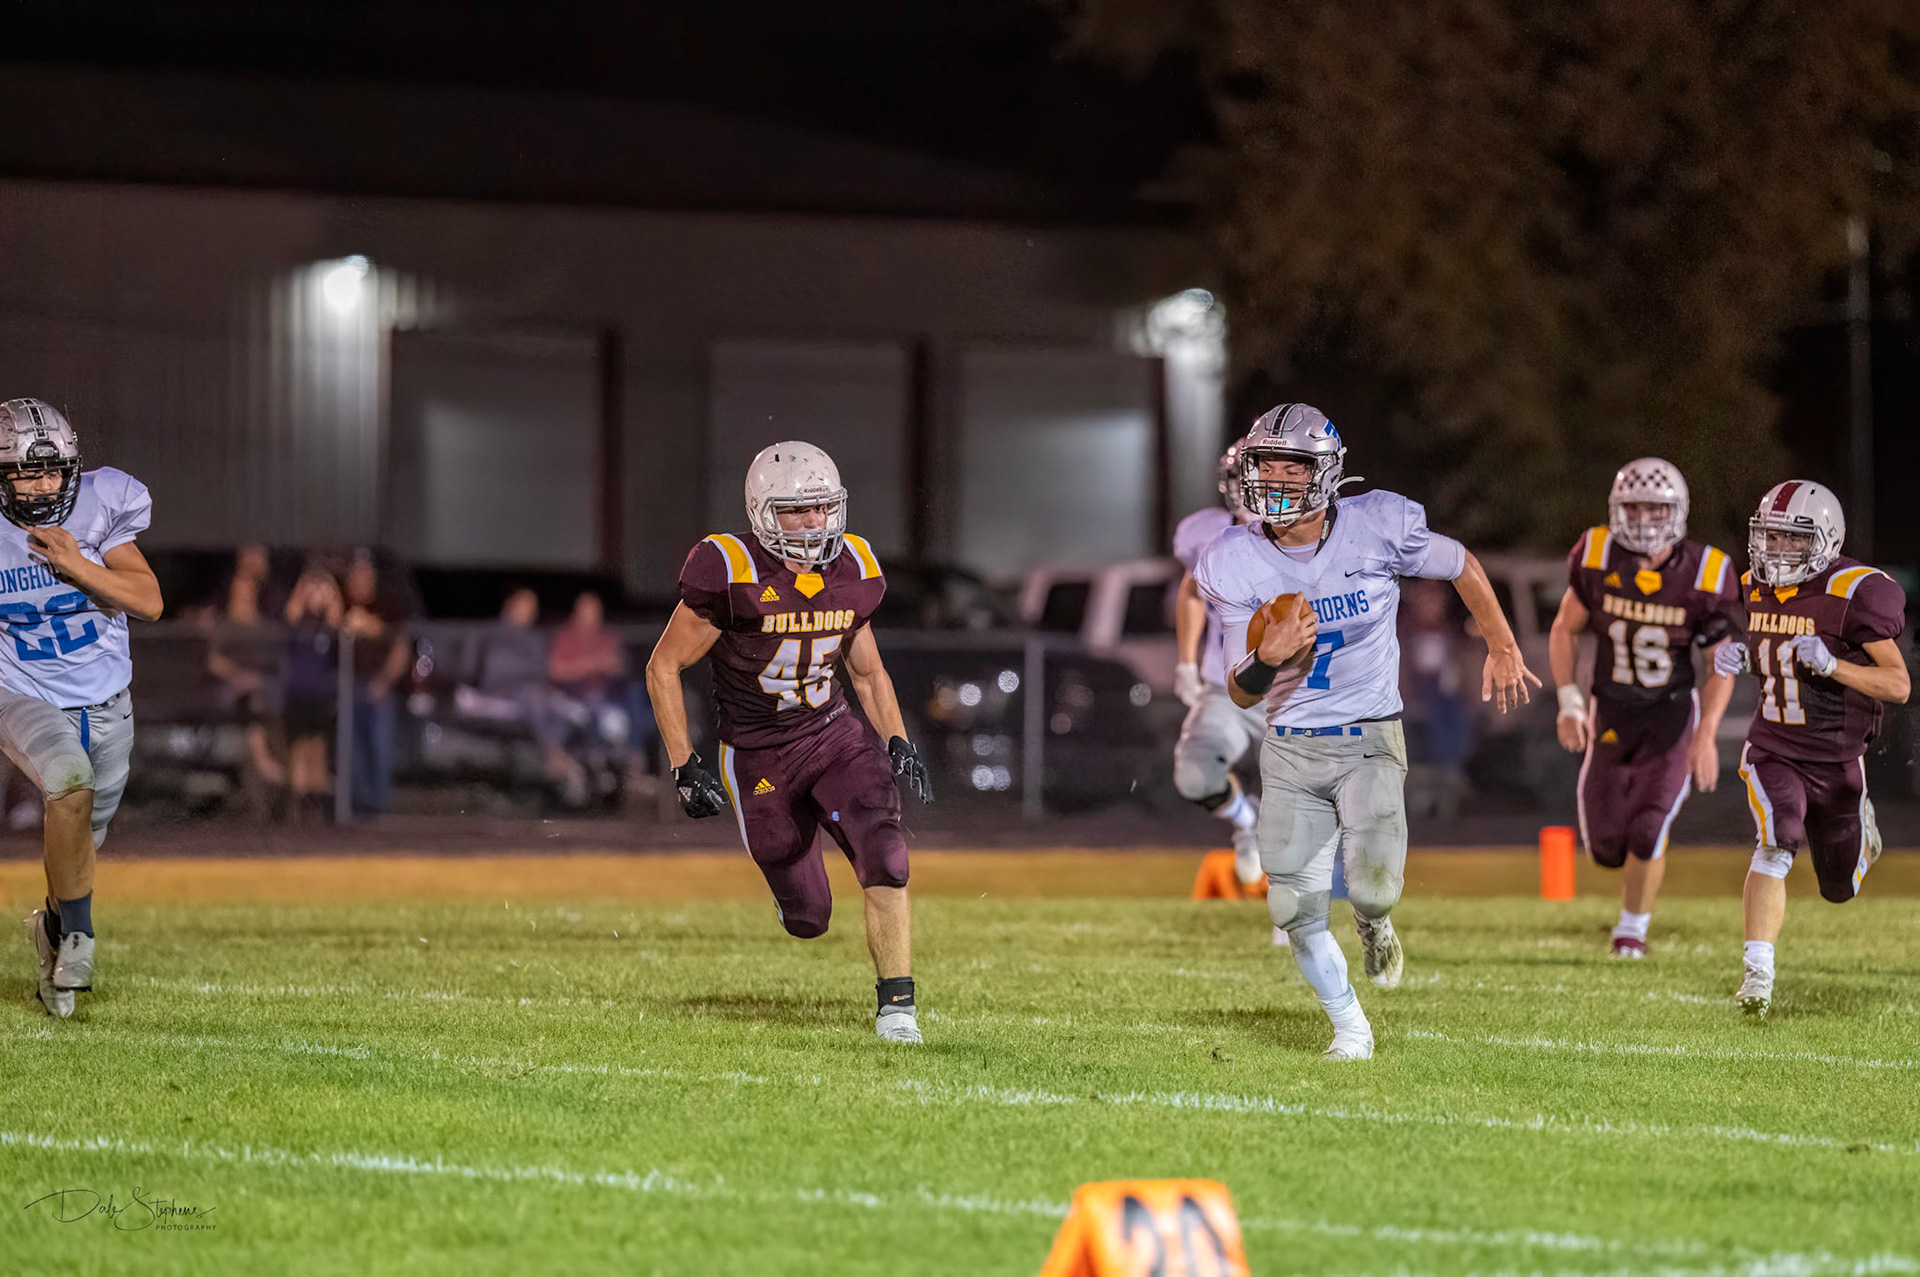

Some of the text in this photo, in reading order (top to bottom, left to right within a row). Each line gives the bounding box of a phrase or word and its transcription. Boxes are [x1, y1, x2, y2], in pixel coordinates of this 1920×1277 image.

[1262, 438, 1288, 446] Riddell
[0, 591, 99, 661] 22
[761, 609, 855, 634] BULLDOGS
[757, 634, 844, 712] 45
[1307, 630, 1345, 690] 7
[1608, 620, 1673, 688] 16
[1758, 638, 1806, 725] 11
[753, 785, 776, 796] adidas
